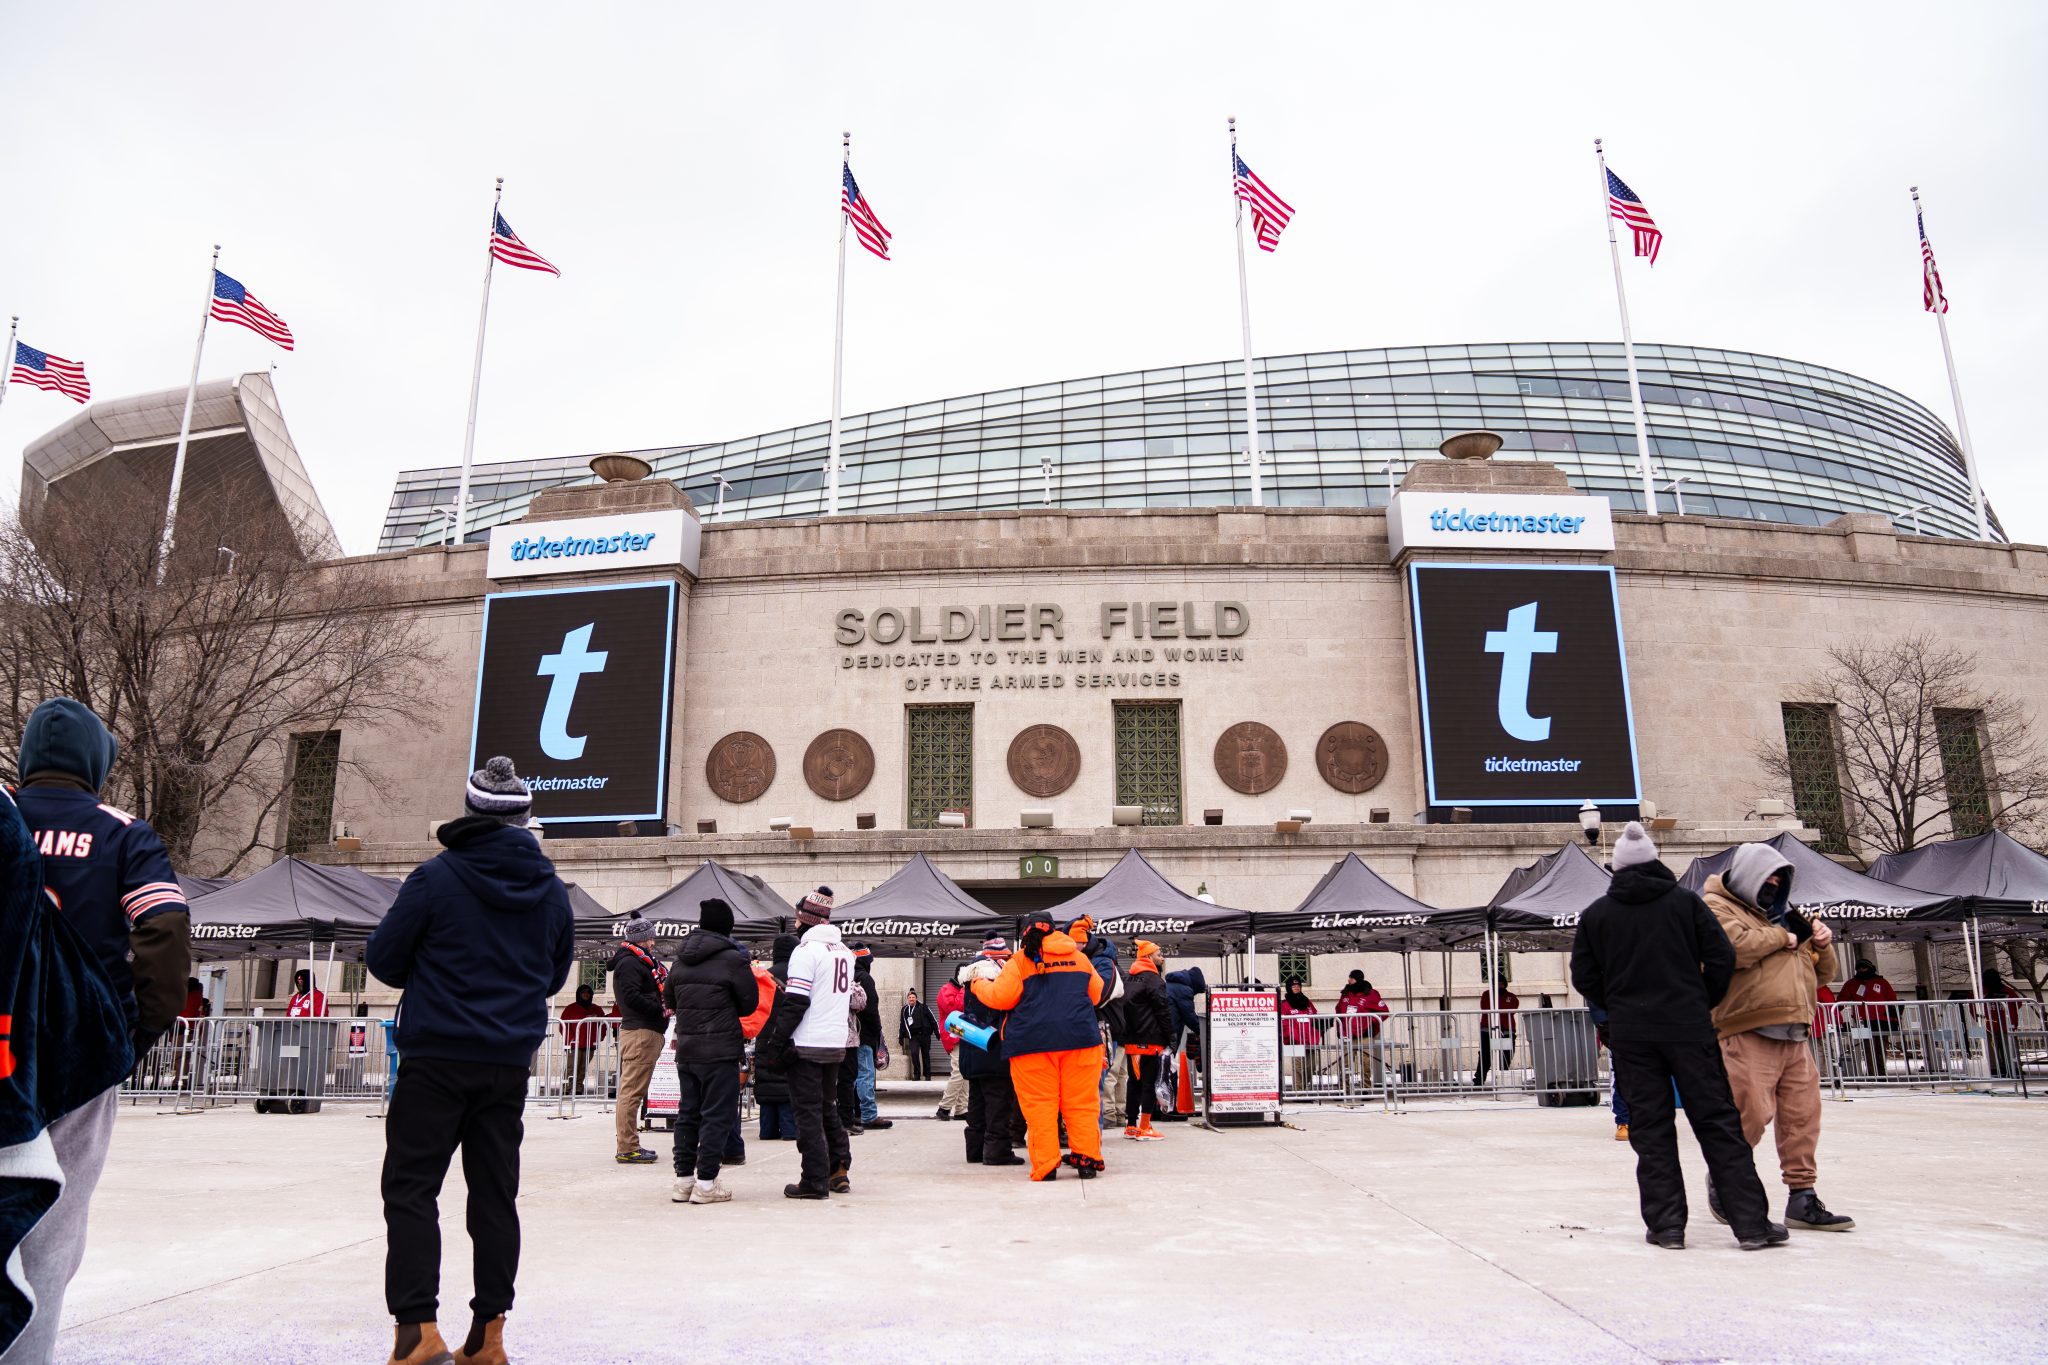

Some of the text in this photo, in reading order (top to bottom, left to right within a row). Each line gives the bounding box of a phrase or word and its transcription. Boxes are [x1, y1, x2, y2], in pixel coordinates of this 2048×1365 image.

[1430, 508, 1586, 534] ticketmaster
[510, 531, 656, 561] ticketmaster
[834, 600, 1250, 645] SOLDIER FIELD
[842, 646, 1245, 669] DEDICATED TO THE MEN AND WOMEN
[904, 671, 1181, 691] OF THE ARMED SERVICES
[1484, 601, 1559, 742] t
[536, 622, 609, 761] t
[1484, 756, 1582, 773] ticketmaster
[840, 917, 960, 936] ticketmaster
[1311, 913, 1432, 929] ticketmaster
[833, 957, 849, 994] 18
[1211, 997, 1275, 1007] ATTENTION
